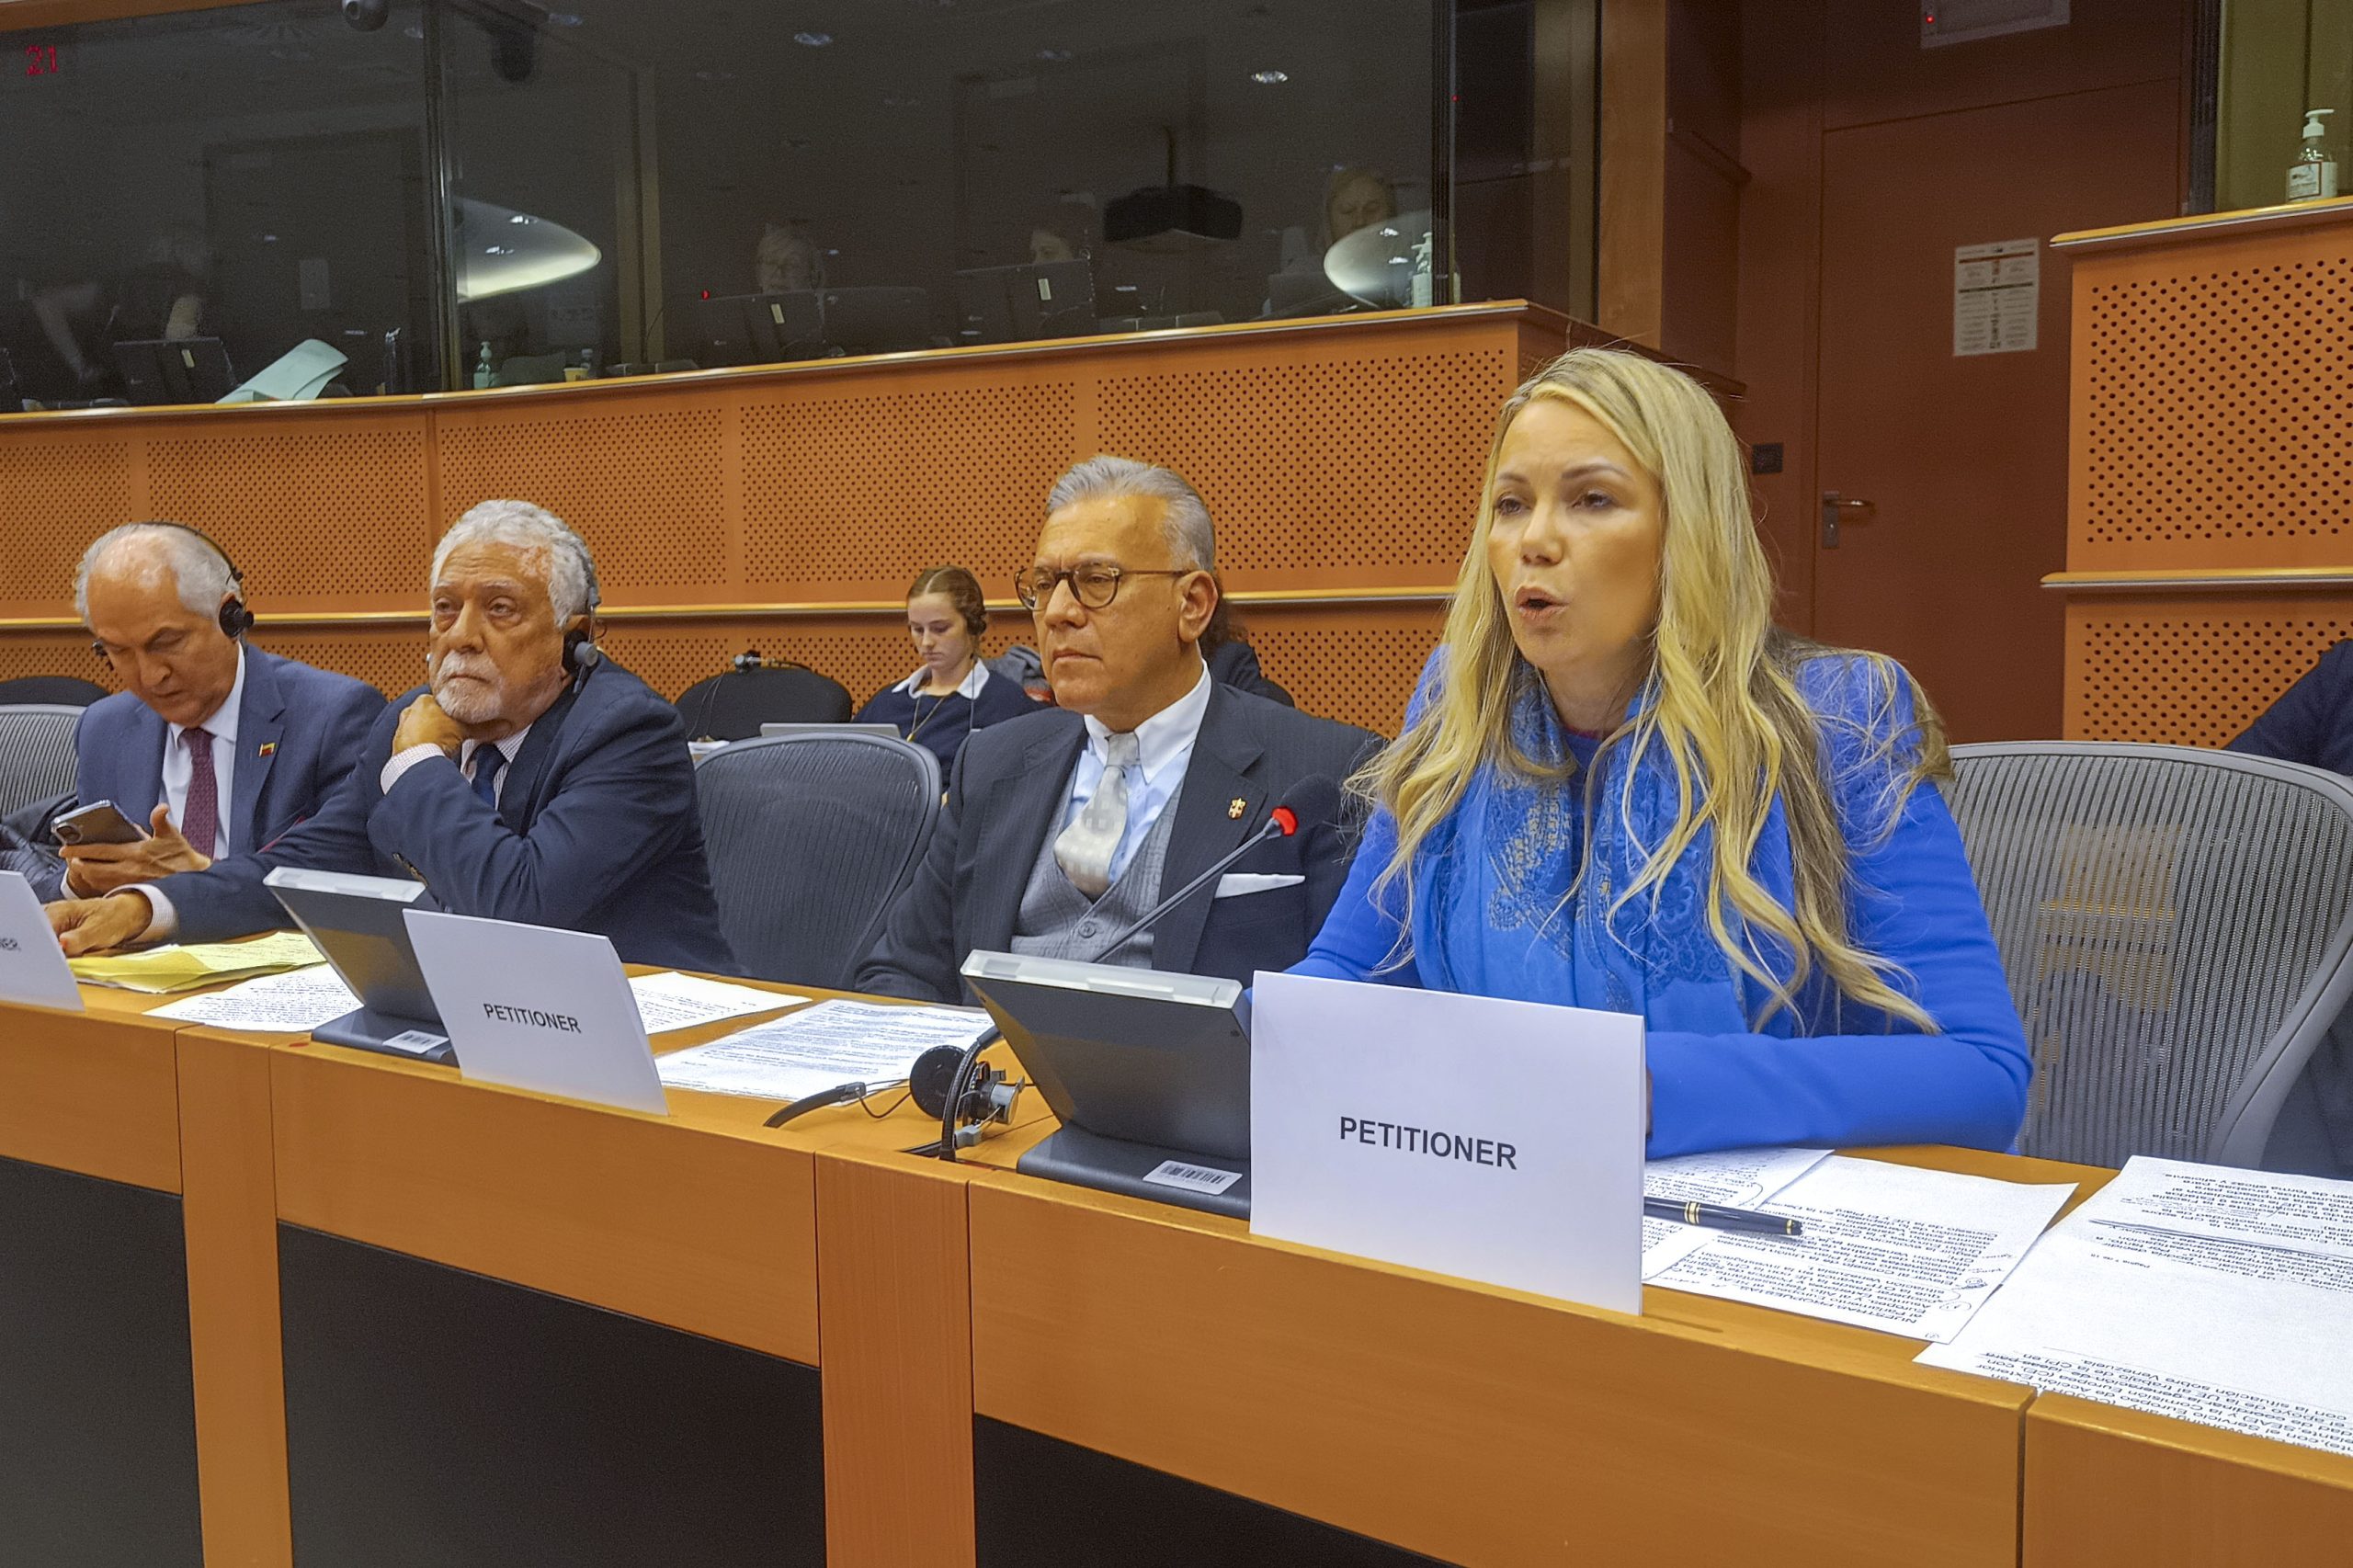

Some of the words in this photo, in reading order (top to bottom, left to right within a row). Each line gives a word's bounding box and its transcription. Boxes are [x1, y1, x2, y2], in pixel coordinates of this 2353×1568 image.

[26, 44, 59, 75] 21
[483, 1003, 582, 1035] PETITIONER
[1340, 1116, 1518, 1170] PETITIONER
